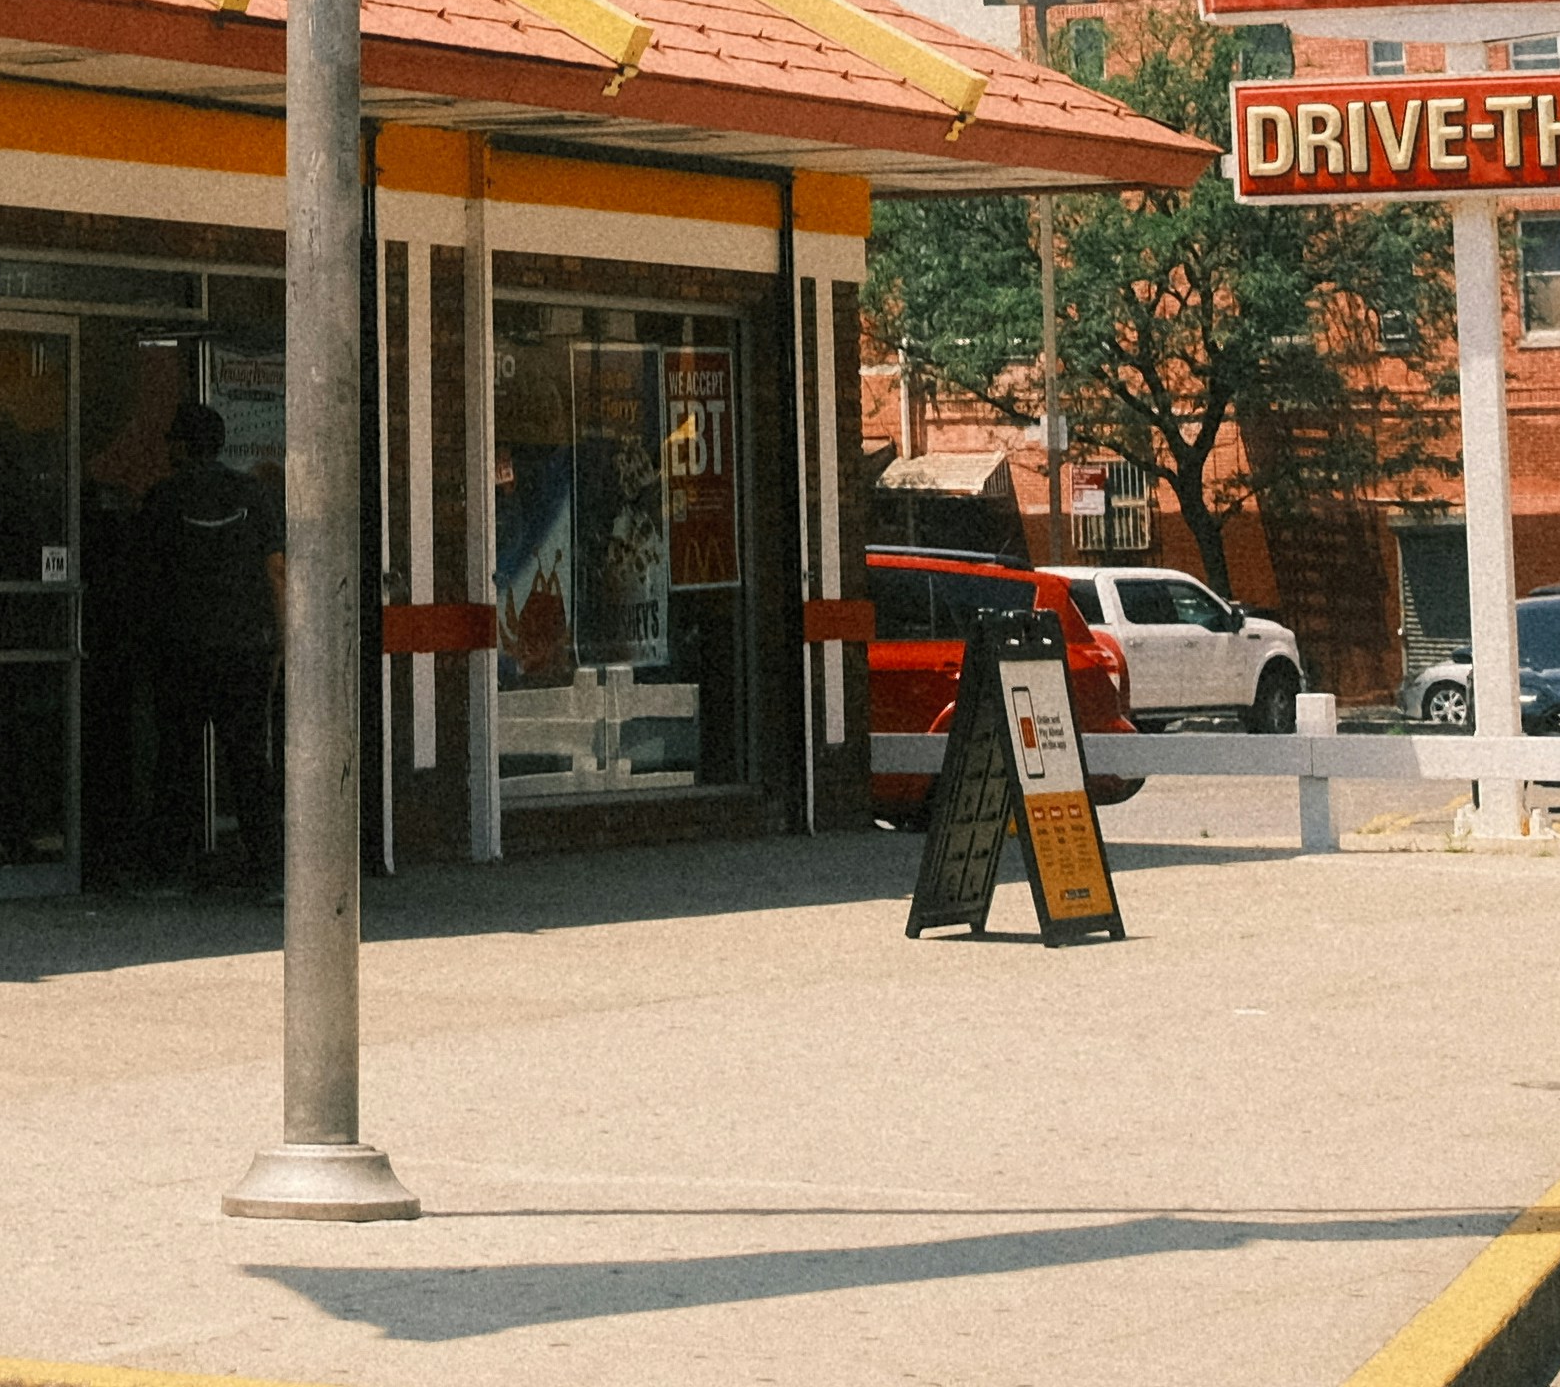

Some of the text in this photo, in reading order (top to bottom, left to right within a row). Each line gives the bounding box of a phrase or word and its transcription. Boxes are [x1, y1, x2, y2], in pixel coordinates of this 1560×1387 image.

[668, 371, 725, 398] WE ACCEPT
[670, 399, 726, 477] EBT
[45, 556, 64, 573] ATM
